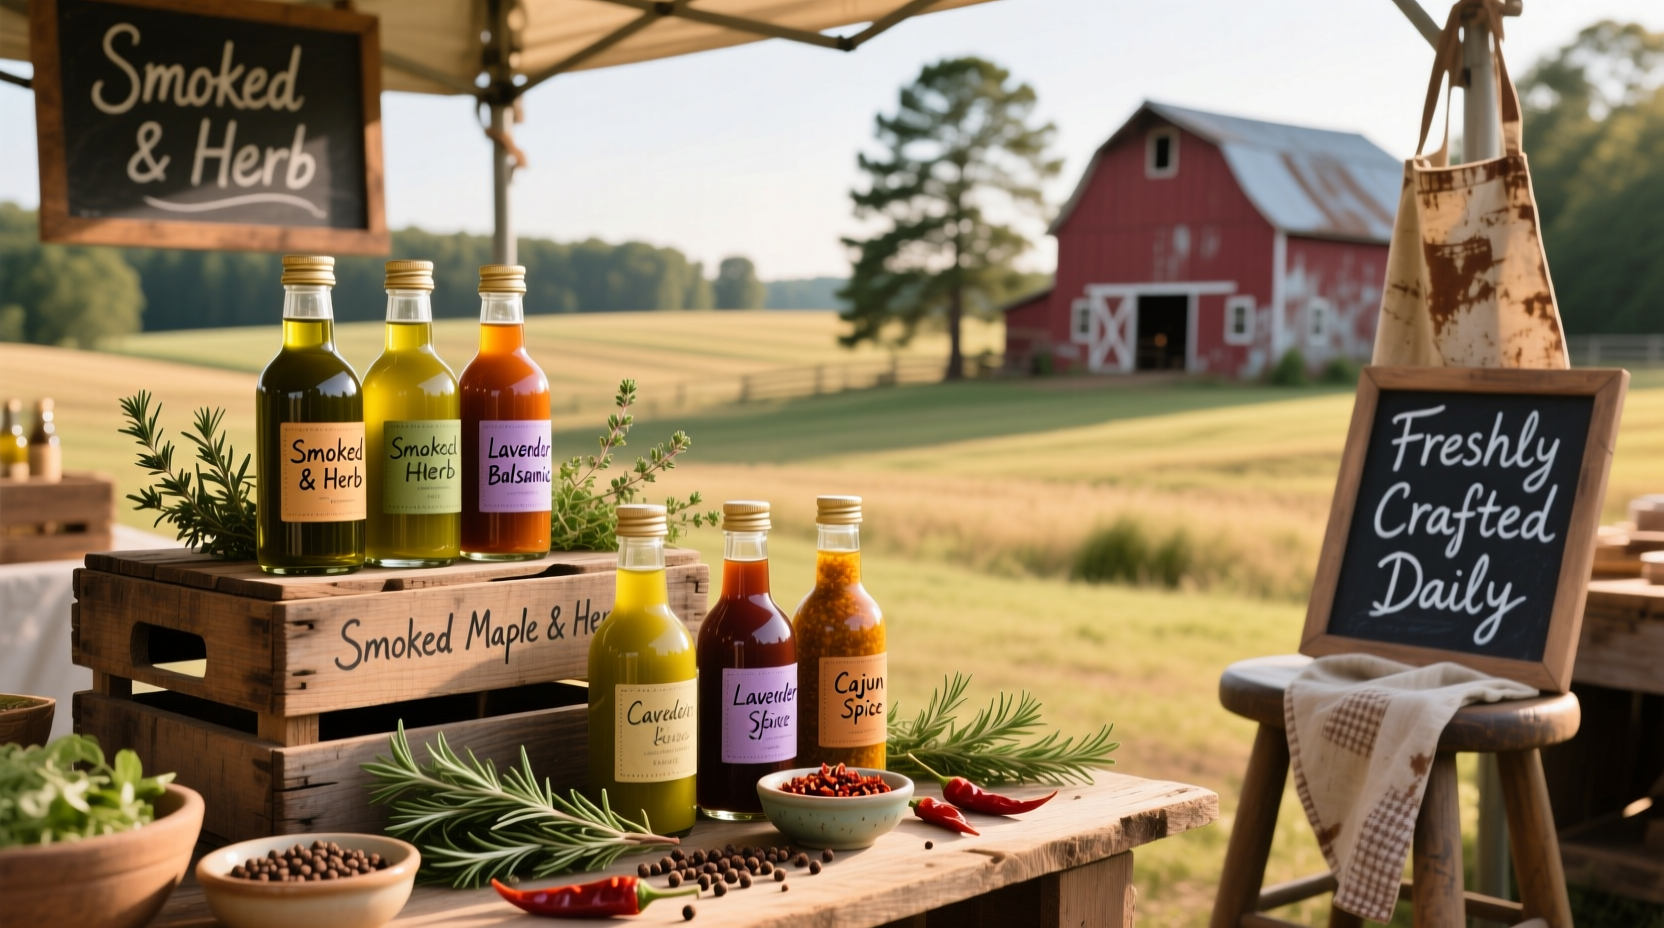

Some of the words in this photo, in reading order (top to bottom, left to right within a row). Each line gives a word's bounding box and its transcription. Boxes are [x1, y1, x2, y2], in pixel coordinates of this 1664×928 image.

[91, 22, 305, 115] Smoked
[127, 120, 171, 184] &
[190, 117, 317, 190] Herb
[290, 436, 363, 464] Smoked
[488, 435, 551, 459] Lavender
[1391, 404, 1560, 493] Freshly
[299, 468, 315, 490] &
[323, 465, 363, 490] Herb
[488, 463, 551, 486] Balsamic
[1374, 481, 1558, 559] Crafted
[1369, 551, 1527, 645] Daily
[334, 612, 454, 671] Smoked
[465, 608, 539, 665] Maple
[547, 605, 566, 640] &
[573, 598, 611, 637] Her
[834, 671, 884, 700] Cajun
[841, 698, 882, 725] Spice
